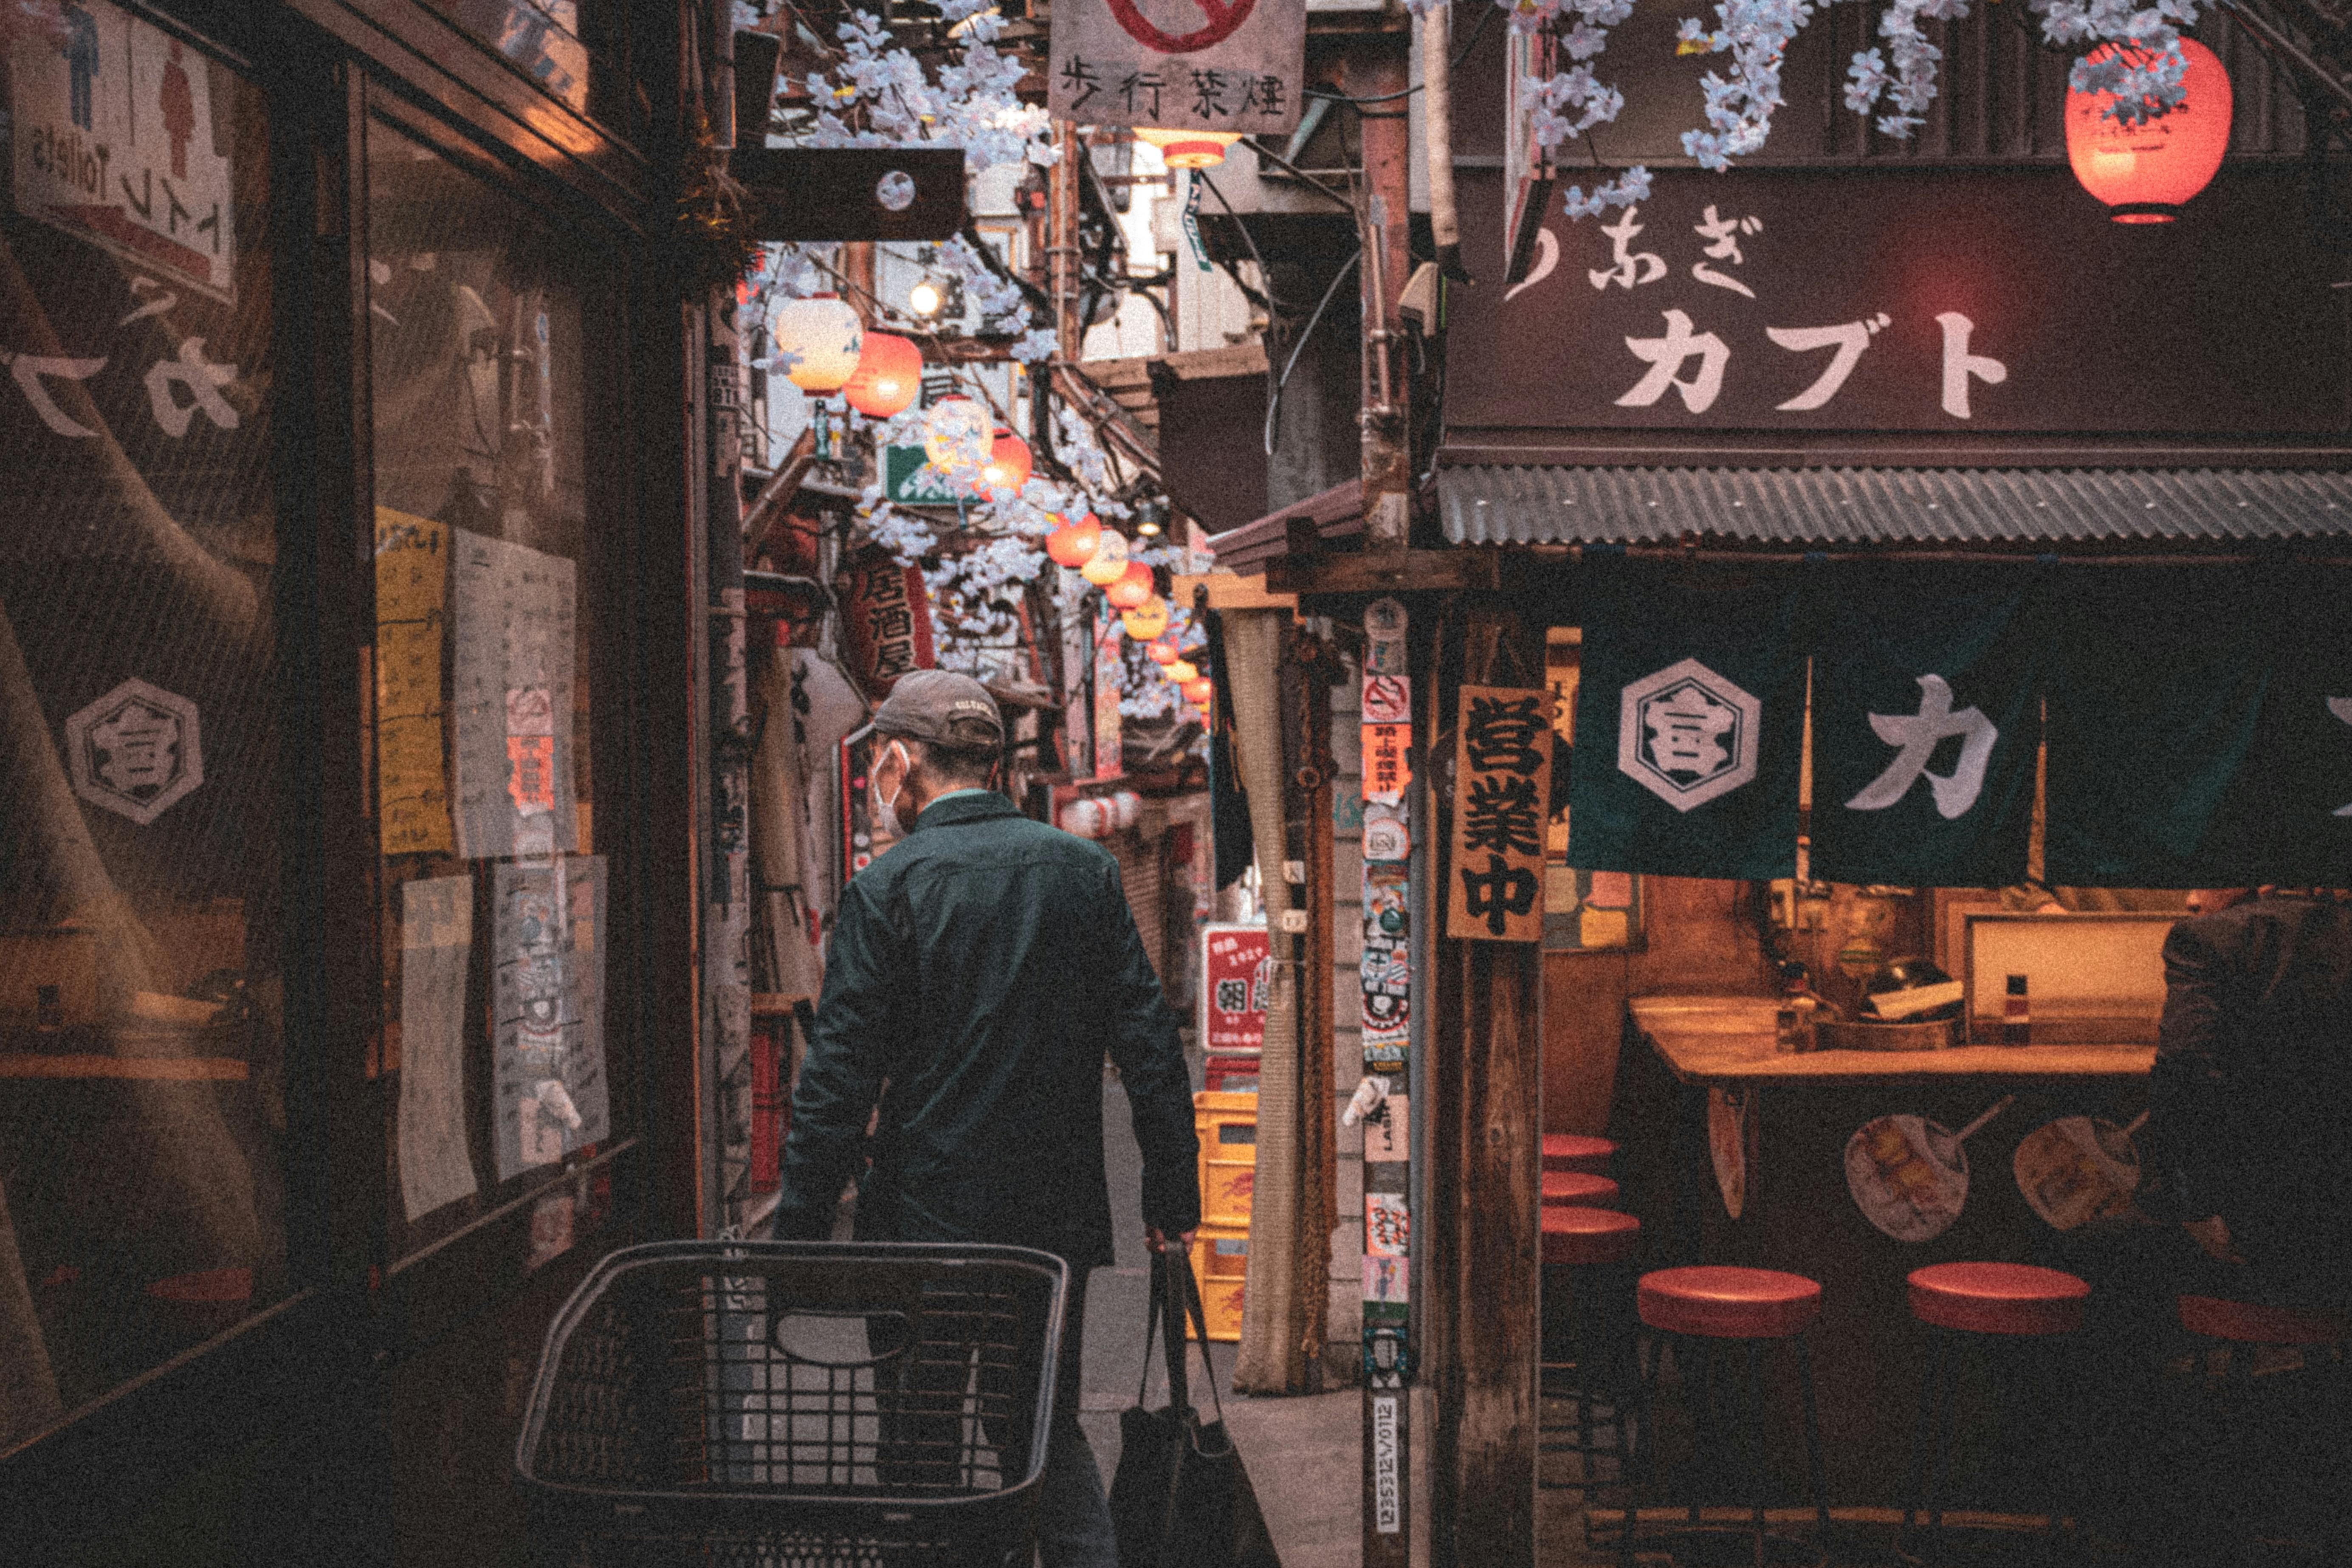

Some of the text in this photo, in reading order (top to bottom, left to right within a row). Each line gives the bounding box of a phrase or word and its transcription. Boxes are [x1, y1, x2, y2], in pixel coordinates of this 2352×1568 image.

[1061, 55, 1285, 120] 歩行禁煙
[1614, 309, 2008, 420] カブト
[862, 566, 917, 681] 居酒屋
[1461, 696, 1547, 935] 営業中
